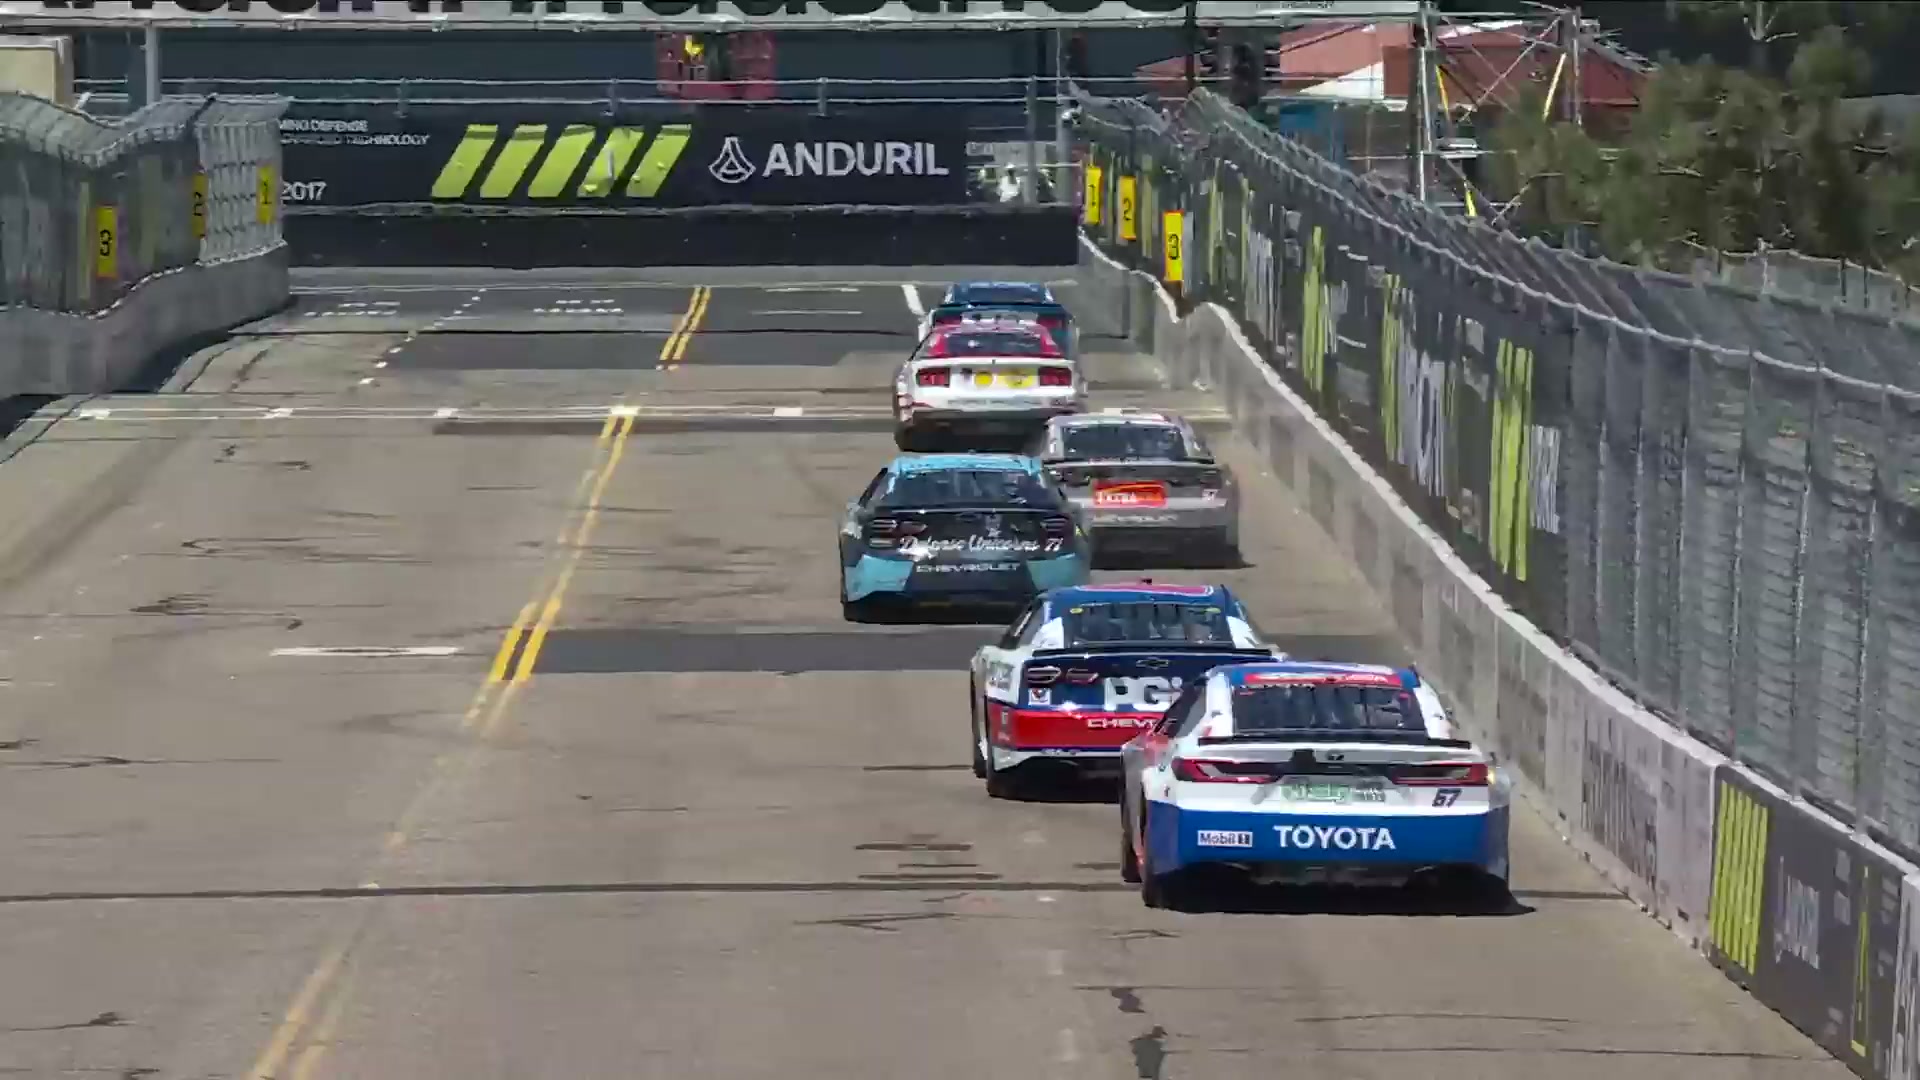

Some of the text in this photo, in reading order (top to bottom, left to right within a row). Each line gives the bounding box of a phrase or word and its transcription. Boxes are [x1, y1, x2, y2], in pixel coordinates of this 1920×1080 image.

[762, 142, 949, 176] ANDURIL
[281, 181, 327, 201] 2017
[1123, 198, 1133, 221] 2
[100, 229, 112, 256] 3
[1168, 234, 1180, 260] 3
[1200, 832, 1236, 845] Mobil
[1273, 825, 1396, 850] TOYOTA
